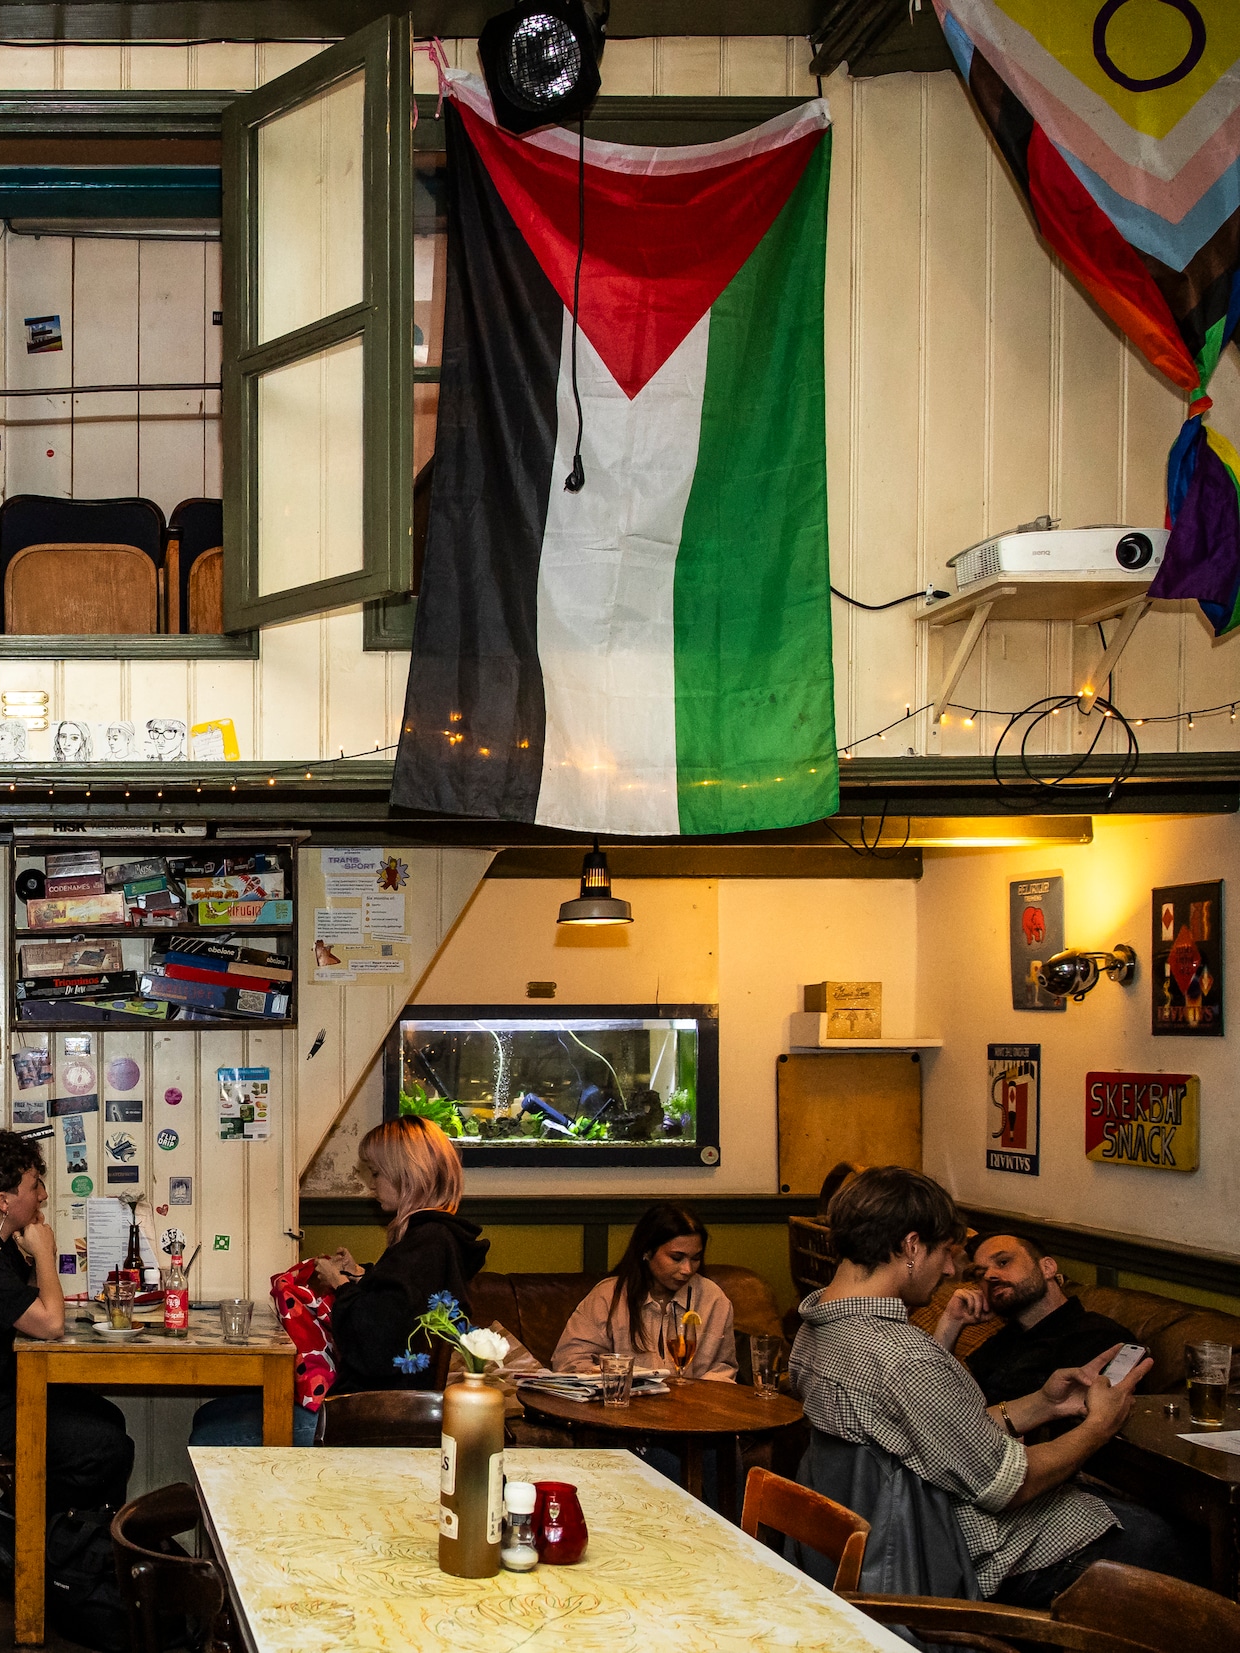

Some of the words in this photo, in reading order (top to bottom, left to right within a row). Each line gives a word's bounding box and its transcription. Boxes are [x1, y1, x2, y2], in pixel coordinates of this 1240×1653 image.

[54, 822, 87, 832] RISK
[49, 884, 90, 893] CODENAMES
[208, 947, 235, 956] abalone
[53, 977, 99, 987] Triominos
[161, 1133, 176, 1141] FLIP
[158, 1138, 174, 1147] DRIP
[1102, 1120, 1176, 1166] SNACK
[990, 1153, 1030, 1171] SALMARI
